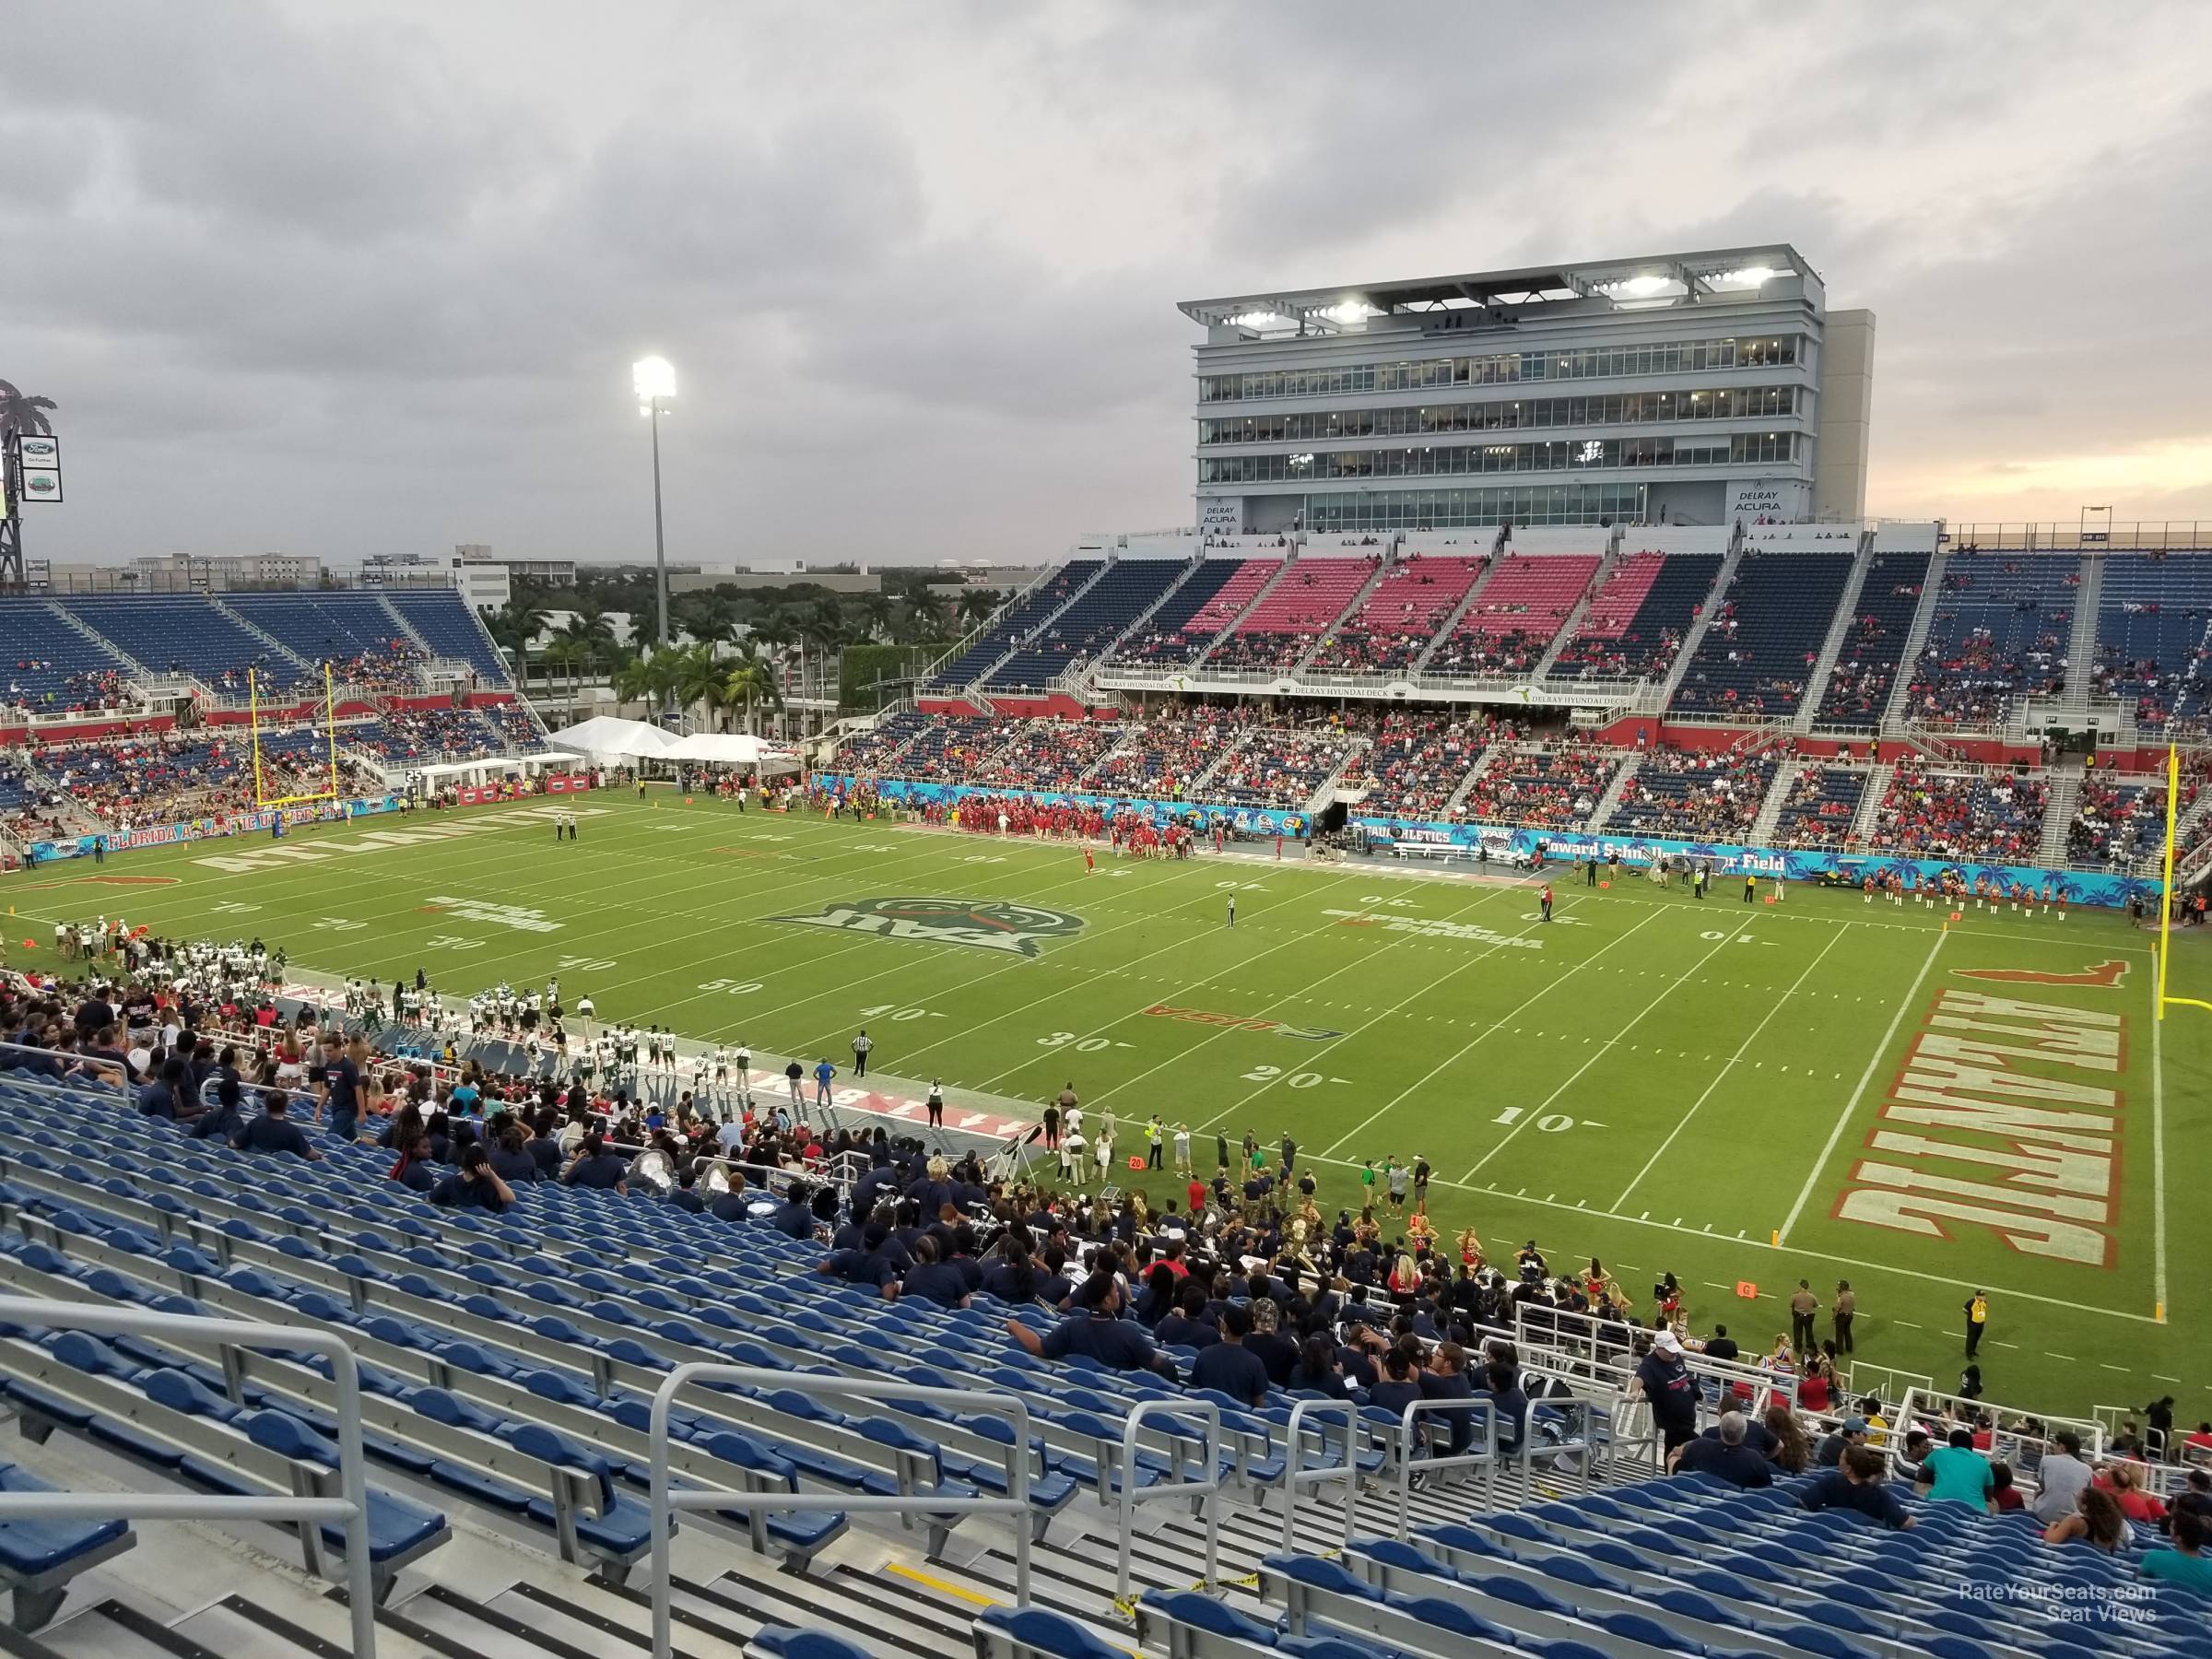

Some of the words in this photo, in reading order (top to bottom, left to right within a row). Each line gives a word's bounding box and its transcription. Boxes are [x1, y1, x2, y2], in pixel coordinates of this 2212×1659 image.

[29, 442, 50, 453] Ford
[1739, 490, 1779, 500] DELRAY
[1734, 502, 1782, 511] ACURA
[1126, 681, 1155, 689] HYUNDAI
[1295, 687, 1327, 695] DELRAY
[1327, 688, 1366, 696] HYUNDAI
[1531, 695, 1563, 704] DELRAY
[1564, 696, 1604, 705] HYUNDAI
[406, 770, 421, 782] 25
[107, 825, 178, 850] FLORIDA
[187, 805, 614, 874] ATLANTIC
[1386, 827, 1452, 843] AHLETICS
[1480, 829, 1512, 840] FAU
[1538, 837, 1599, 856] Howard
[1742, 853, 1785, 871] Field
[1382, 922, 1545, 949] Winning
[1699, 930, 1758, 944] 10
[426, 936, 487, 950] 30
[557, 957, 618, 971] 40
[697, 978, 764, 994] 50
[858, 1004, 926, 1021] 40
[665, 1038, 673, 1046] 16
[1035, 1031, 1112, 1052] 30
[582, 1056, 591, 1065] 39
[1238, 1065, 1324, 1088] 20
[1489, 1105, 1574, 1133] 10
[1829, 988, 2126, 1269] ATLANTIC
[1131, 1158, 1141, 1168] 20
[1743, 1284, 1751, 1295] G
